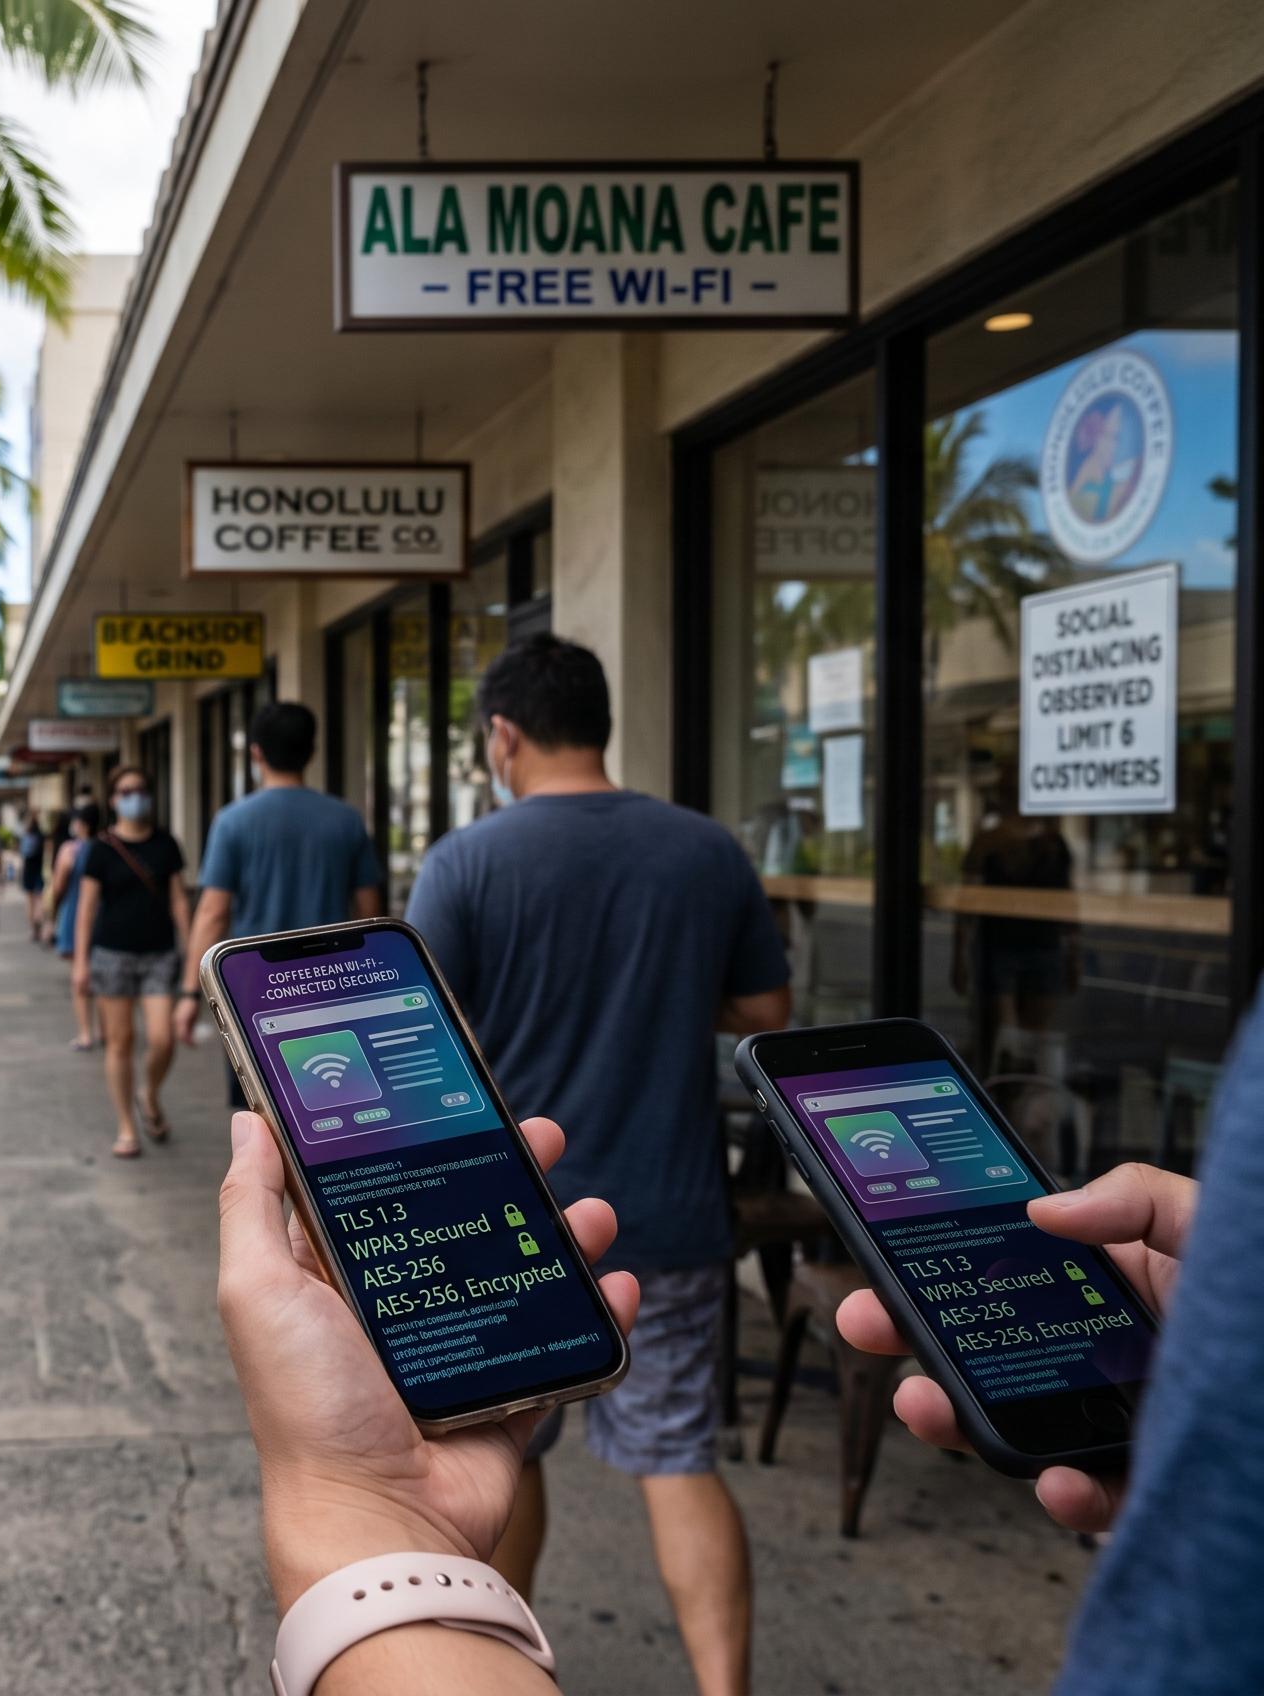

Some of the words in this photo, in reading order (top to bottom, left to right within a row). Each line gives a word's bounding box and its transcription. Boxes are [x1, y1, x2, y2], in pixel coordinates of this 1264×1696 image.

[361, 184, 470, 256] ALA
[488, 183, 685, 256] MOANA
[701, 182, 841, 255] CAFE
[467, 268, 593, 306] FREE
[609, 267, 732, 304] WI-FI
[211, 486, 444, 516] HONOLULU
[214, 524, 381, 553] COFFEE
[102, 620, 259, 645] BEACHSIDE
[1057, 600, 1134, 638] SOCIAL
[135, 648, 224, 672] GRIND
[1034, 634, 1162, 678] DISTANCING
[1038, 677, 1154, 716] OBSERVED
[1057, 721, 1114, 752] LIMIT
[1121, 718, 1135, 748] 6
[1032, 757, 1161, 792] CUSTOMERS
[268, 967, 312, 985] COFFEE
[338, 968, 400, 990] (SECURED)
[335, 1208, 374, 1232] TLS
[376, 1203, 408, 1224] 1.3
[347, 1233, 409, 1260] WPA3
[413, 1213, 492, 1247] Secured
[363, 1255, 446, 1289] AES-256
[902, 1259, 941, 1280] TLS
[943, 1255, 973, 1274] 1.3
[376, 1284, 465, 1318] AES-256,
[465, 1258, 567, 1299] Encrypted
[919, 1282, 978, 1303] WPA3
[983, 1267, 1056, 1294] Secured
[939, 1300, 1016, 1328] AES-256
[955, 1328, 1038, 1353] AES-256,
[1038, 1308, 1134, 1342] Encrypted
